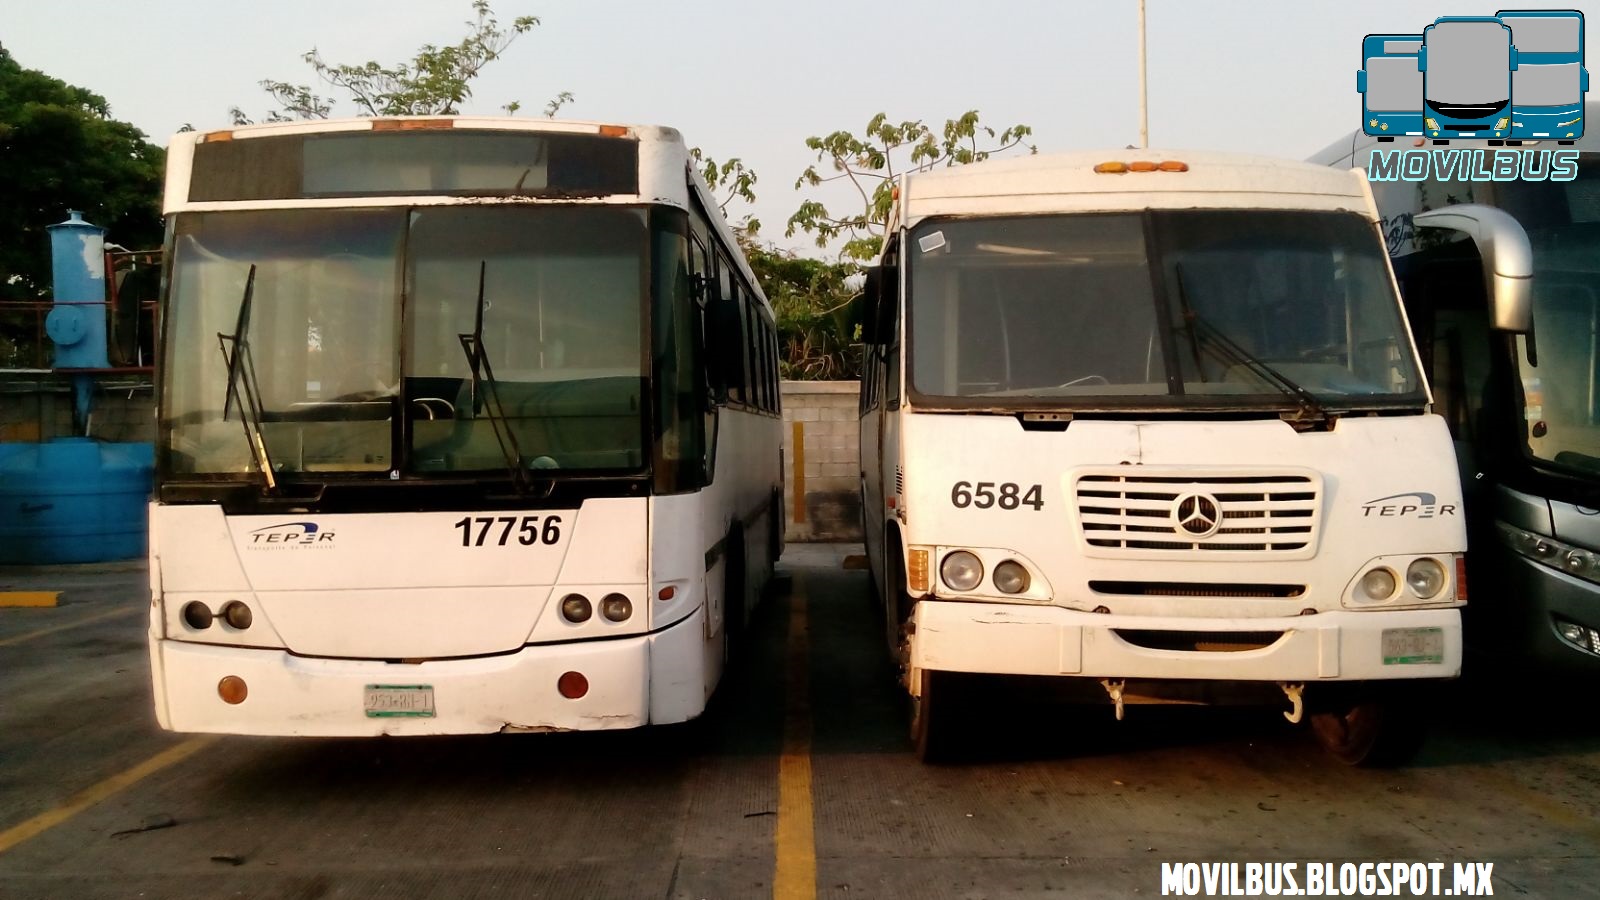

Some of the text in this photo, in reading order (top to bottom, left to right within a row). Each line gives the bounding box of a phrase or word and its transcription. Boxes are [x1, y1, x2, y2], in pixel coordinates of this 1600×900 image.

[951, 481, 1044, 511] 6584
[1361, 504, 1457, 518] TEPER
[252, 531, 336, 544] TEPER
[454, 515, 562, 547] 17756
